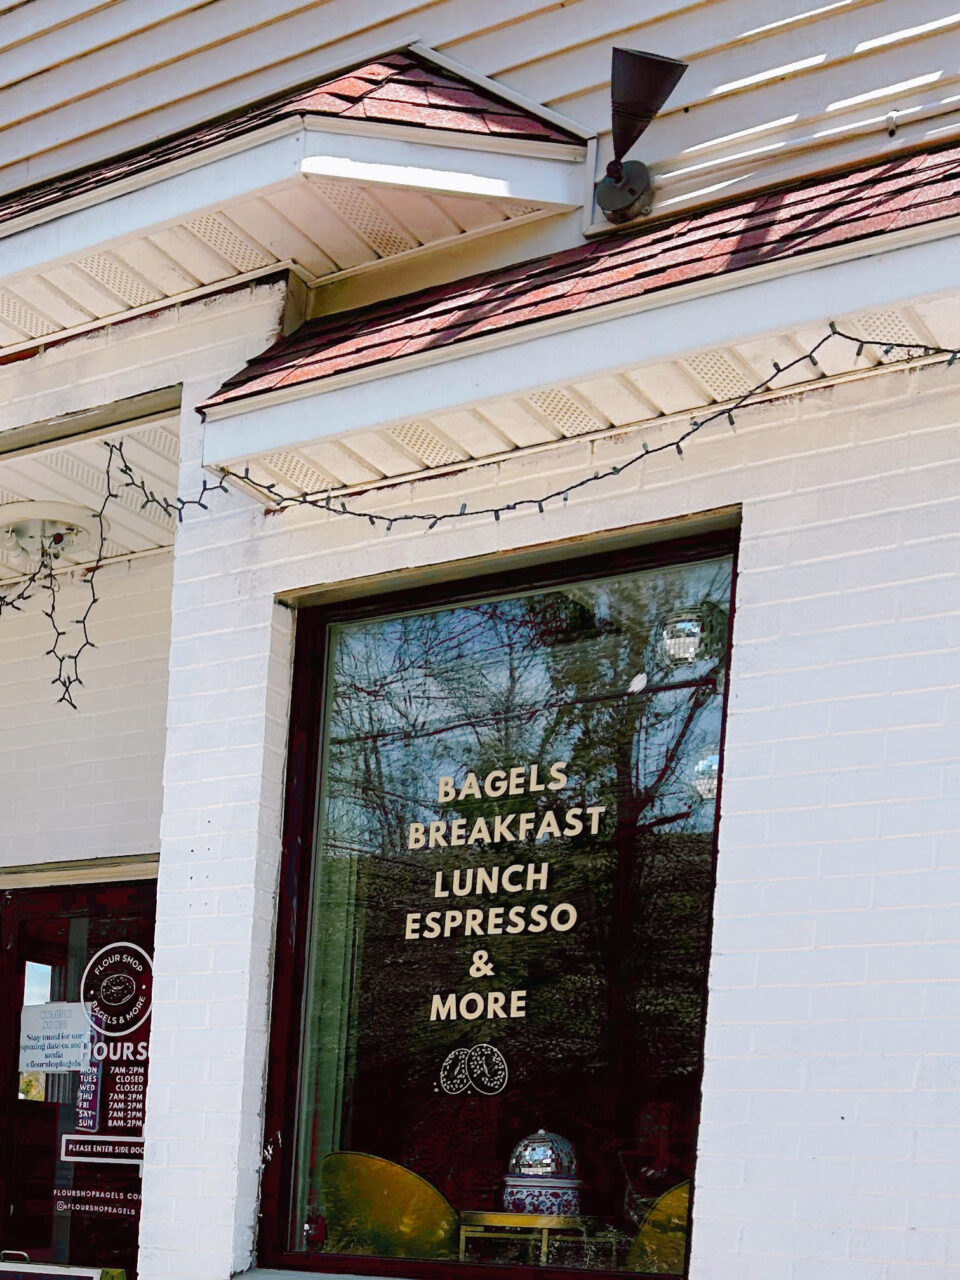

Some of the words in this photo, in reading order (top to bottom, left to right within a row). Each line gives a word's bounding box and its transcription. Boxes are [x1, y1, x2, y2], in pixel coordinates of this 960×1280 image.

[437, 761, 568, 803] BAGELS
[407, 805, 607, 850] BREAKFAST
[434, 862, 549, 898] LUNCH
[404, 902, 578, 940] ESPRESSO
[94, 953, 121, 976] FLOUR
[122, 954, 143, 972] SHOP
[469, 949, 496, 978] &
[91, 1000, 117, 1025] BAGELS
[119, 1016, 125, 1024] &
[126, 996, 146, 1021] MORE
[429, 989, 527, 1021] MORE
[80, 1066, 97, 1074] MON
[110, 1066, 145, 1074] 7AM-2PM
[80, 1075, 97, 1083] TUES
[115, 1075, 144, 1083] CLOSED
[79, 1092, 93, 1100] THU
[108, 1092, 143, 1100] 7AM-2PM
[115, 1084, 144, 1092] CLOSED
[78, 1101, 90, 1109] FRI
[108, 1101, 143, 1109] 7AM-2PM
[78, 1110, 92, 1118] SAT
[108, 1110, 143, 1118] 7AM-2PM
[78, 1119, 93, 1127] SUN
[107, 1119, 143, 1127] 8AM-2PM
[68, 1143, 92, 1152] PLEASE
[93, 1144, 113, 1153] ENTER
[114, 1146, 129, 1154] SIDE
